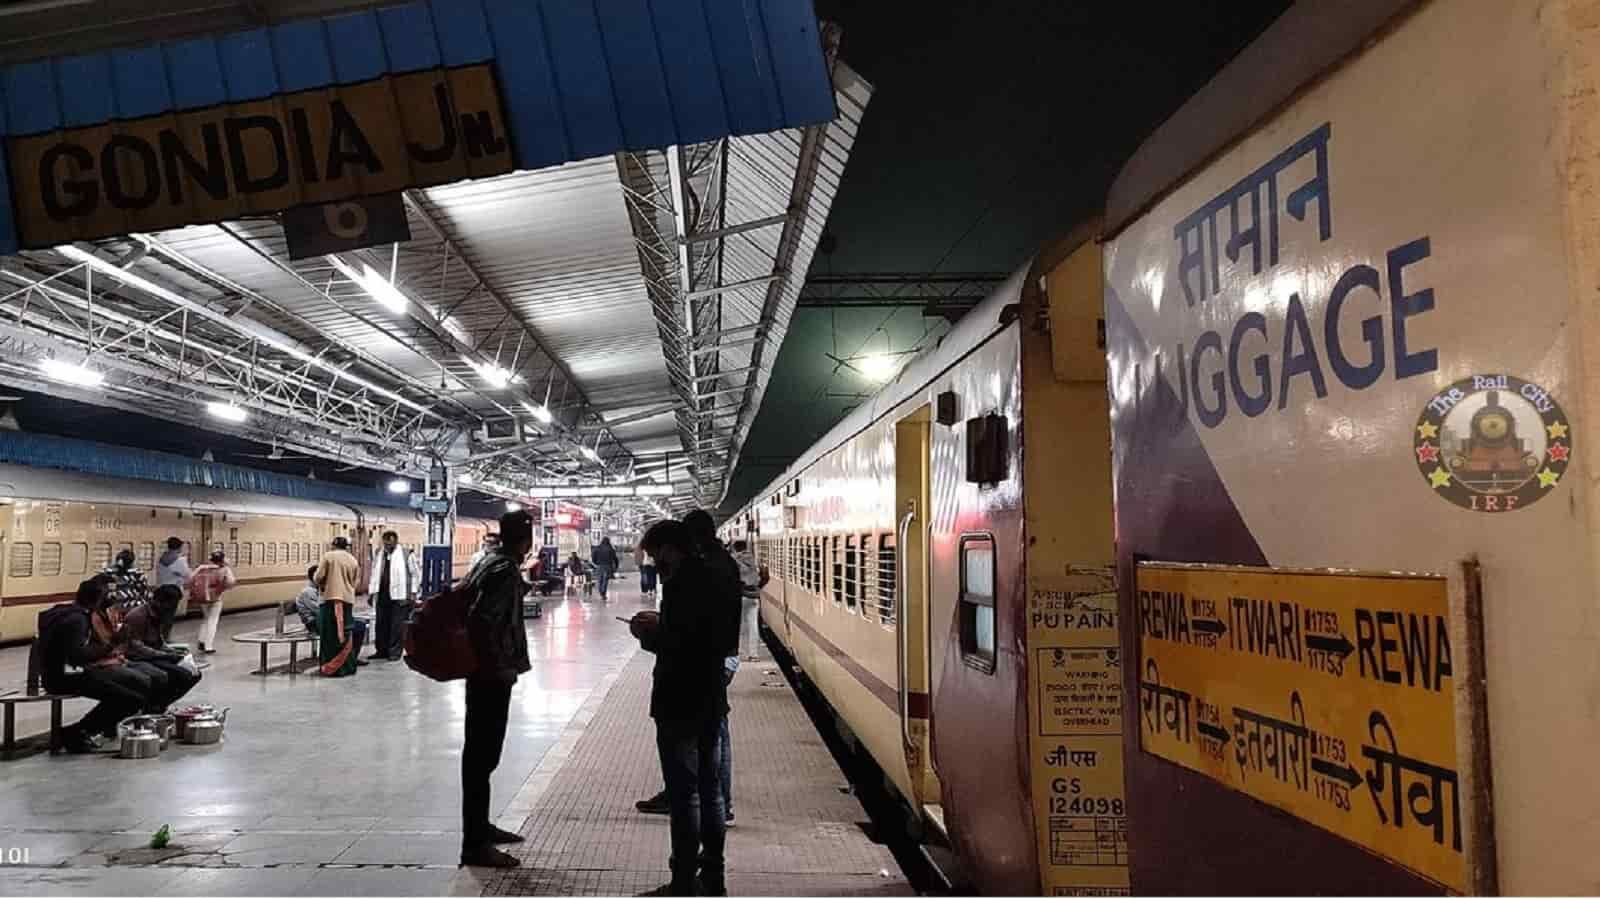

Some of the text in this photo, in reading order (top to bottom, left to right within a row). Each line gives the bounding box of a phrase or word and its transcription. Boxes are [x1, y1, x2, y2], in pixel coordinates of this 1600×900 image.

[38, 100, 384, 222] GONDIA
[1174, 121, 1332, 306] सामान
[1064, 612, 1118, 629] PAIN
[1139, 590, 1192, 645] REWA
[1227, 596, 1303, 662] ITWARI
[1354, 608, 1453, 692] REWA
[1307, 651, 1344, 679] 11753
[1140, 657, 1192, 744] रीवा
[1232, 690, 1311, 793] इतवारी
[1361, 710, 1463, 853] रीवा
[1051, 777, 1082, 794] GS
[1313, 777, 1351, 812] 11753
[1049, 796, 1124, 816] 124098
